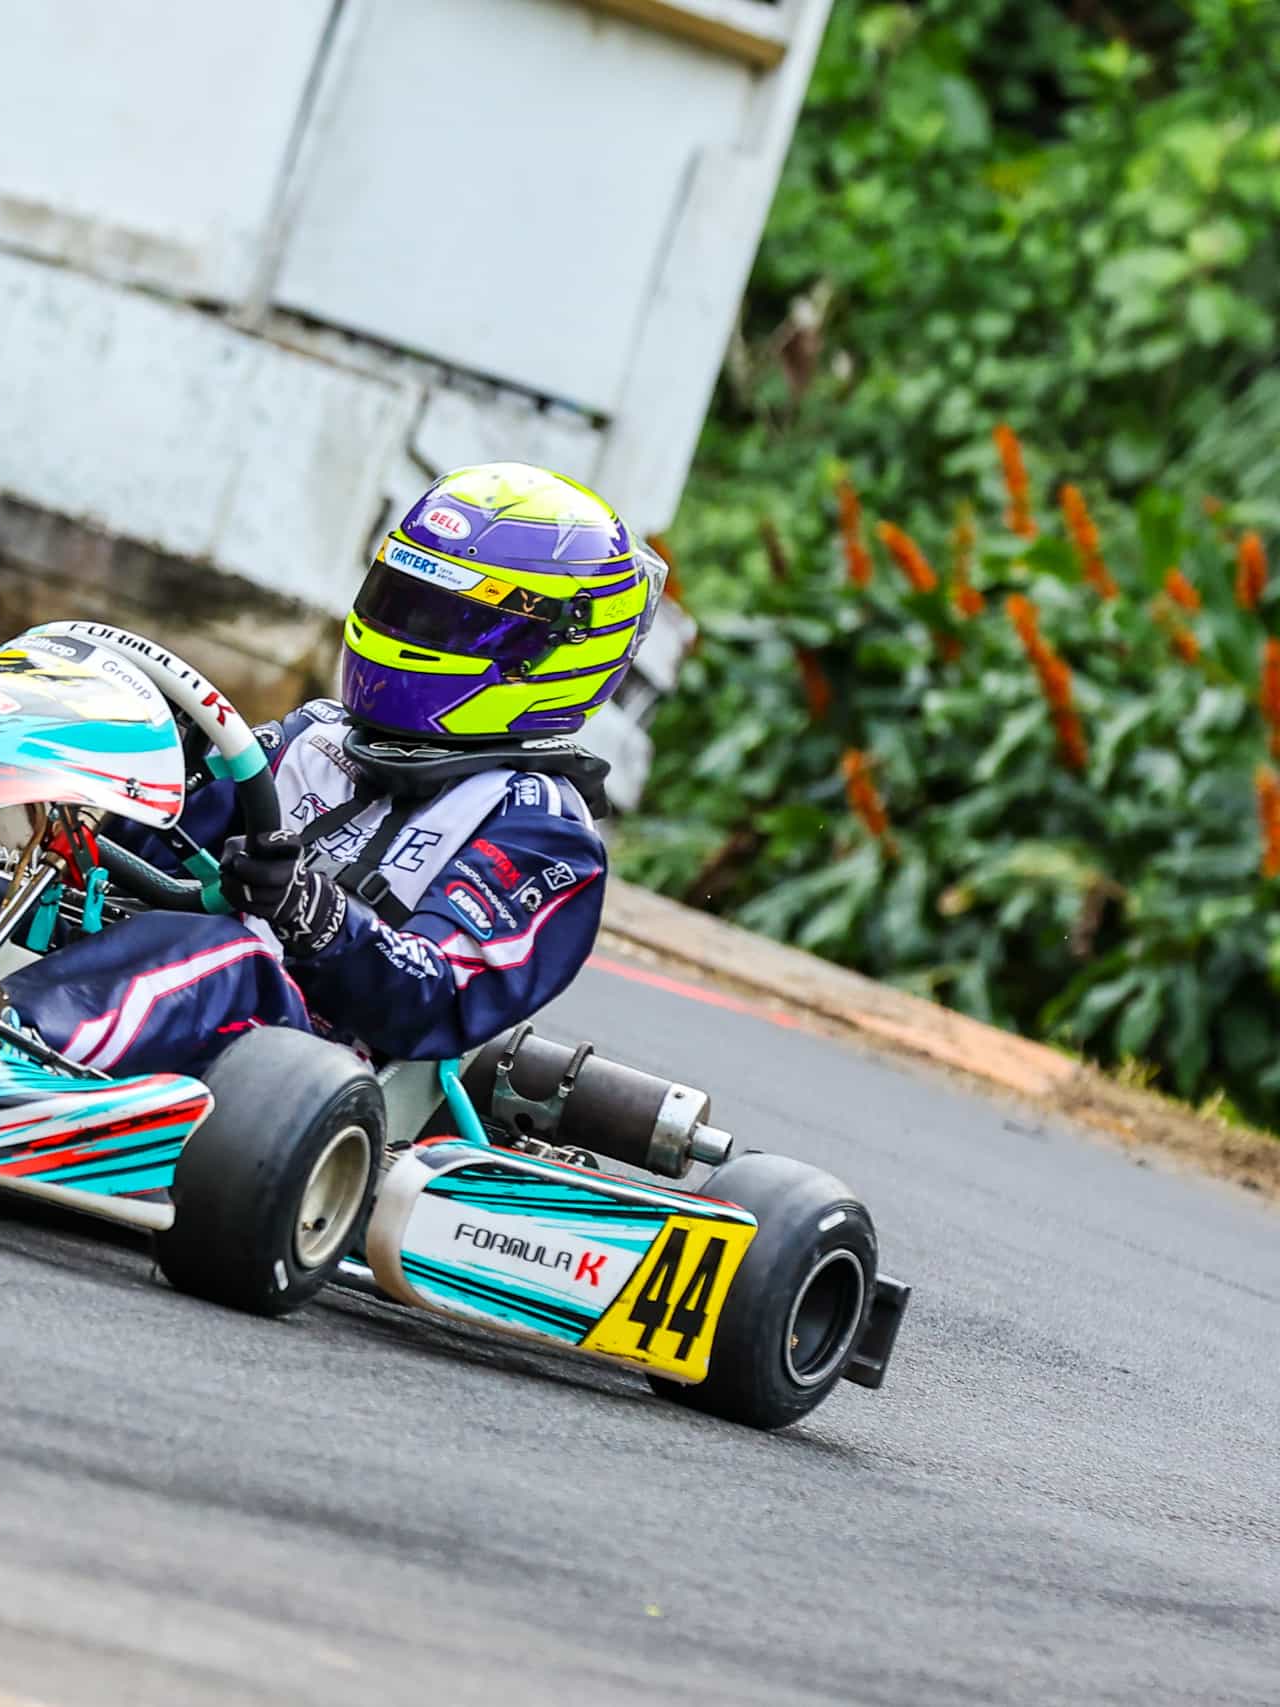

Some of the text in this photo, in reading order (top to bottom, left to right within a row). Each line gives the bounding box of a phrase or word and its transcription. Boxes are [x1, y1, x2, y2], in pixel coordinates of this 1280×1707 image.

[429, 511, 463, 534] BELL
[69, 622, 237, 727] FORMULA K
[101, 659, 153, 702] Group
[447, 888, 493, 929] HRV
[454, 1222, 608, 1287] FORMULA K
[627, 1227, 729, 1362] 44
